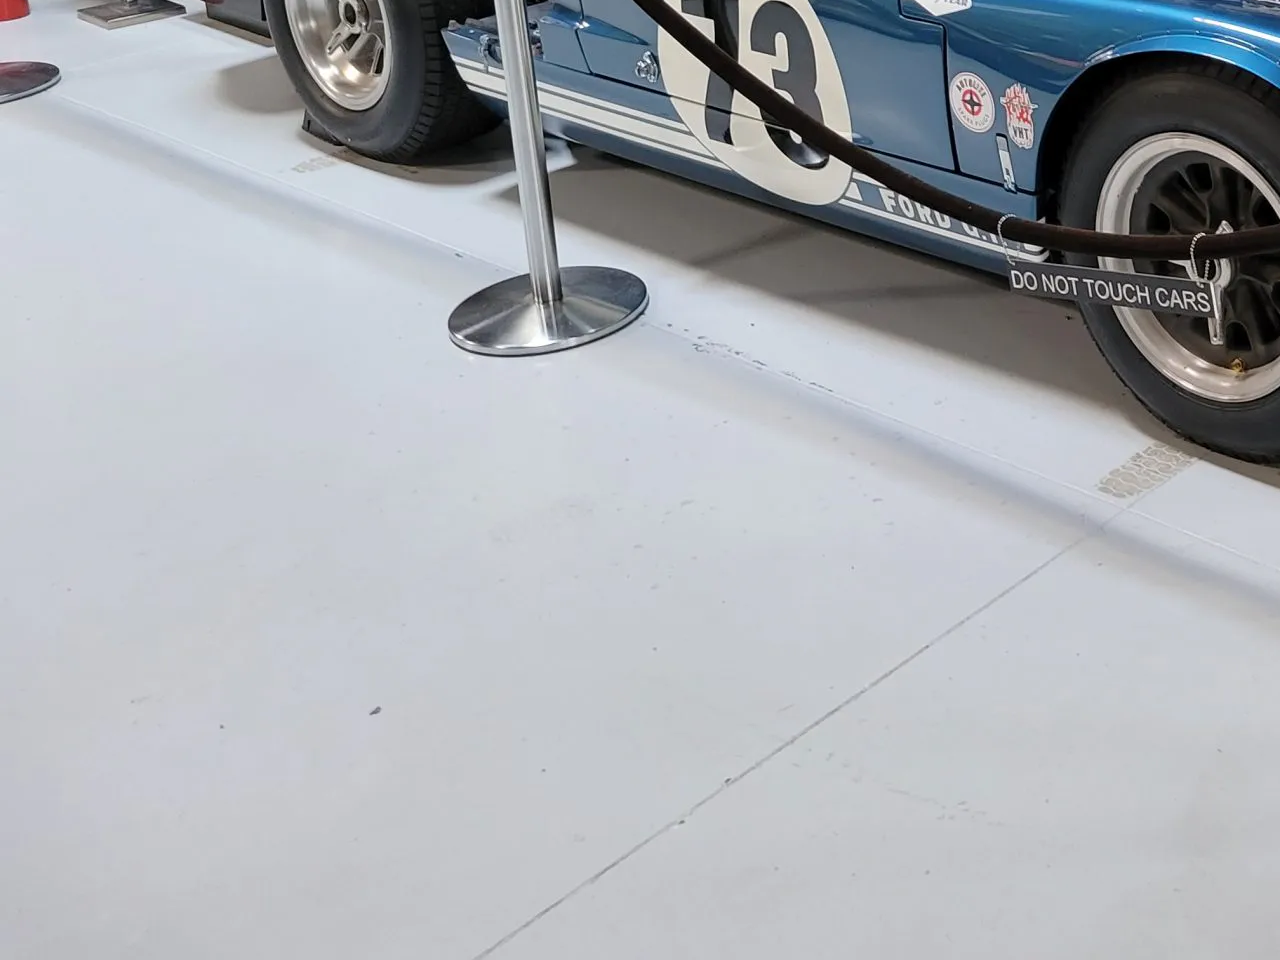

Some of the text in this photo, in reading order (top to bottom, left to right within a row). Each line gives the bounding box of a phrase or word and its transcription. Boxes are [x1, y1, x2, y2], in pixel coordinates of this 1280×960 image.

[1013, 125, 1029, 140] VHT
[879, 187, 951, 228] FORD
[1011, 270, 1212, 312] DO NOT TOUCH CARS
